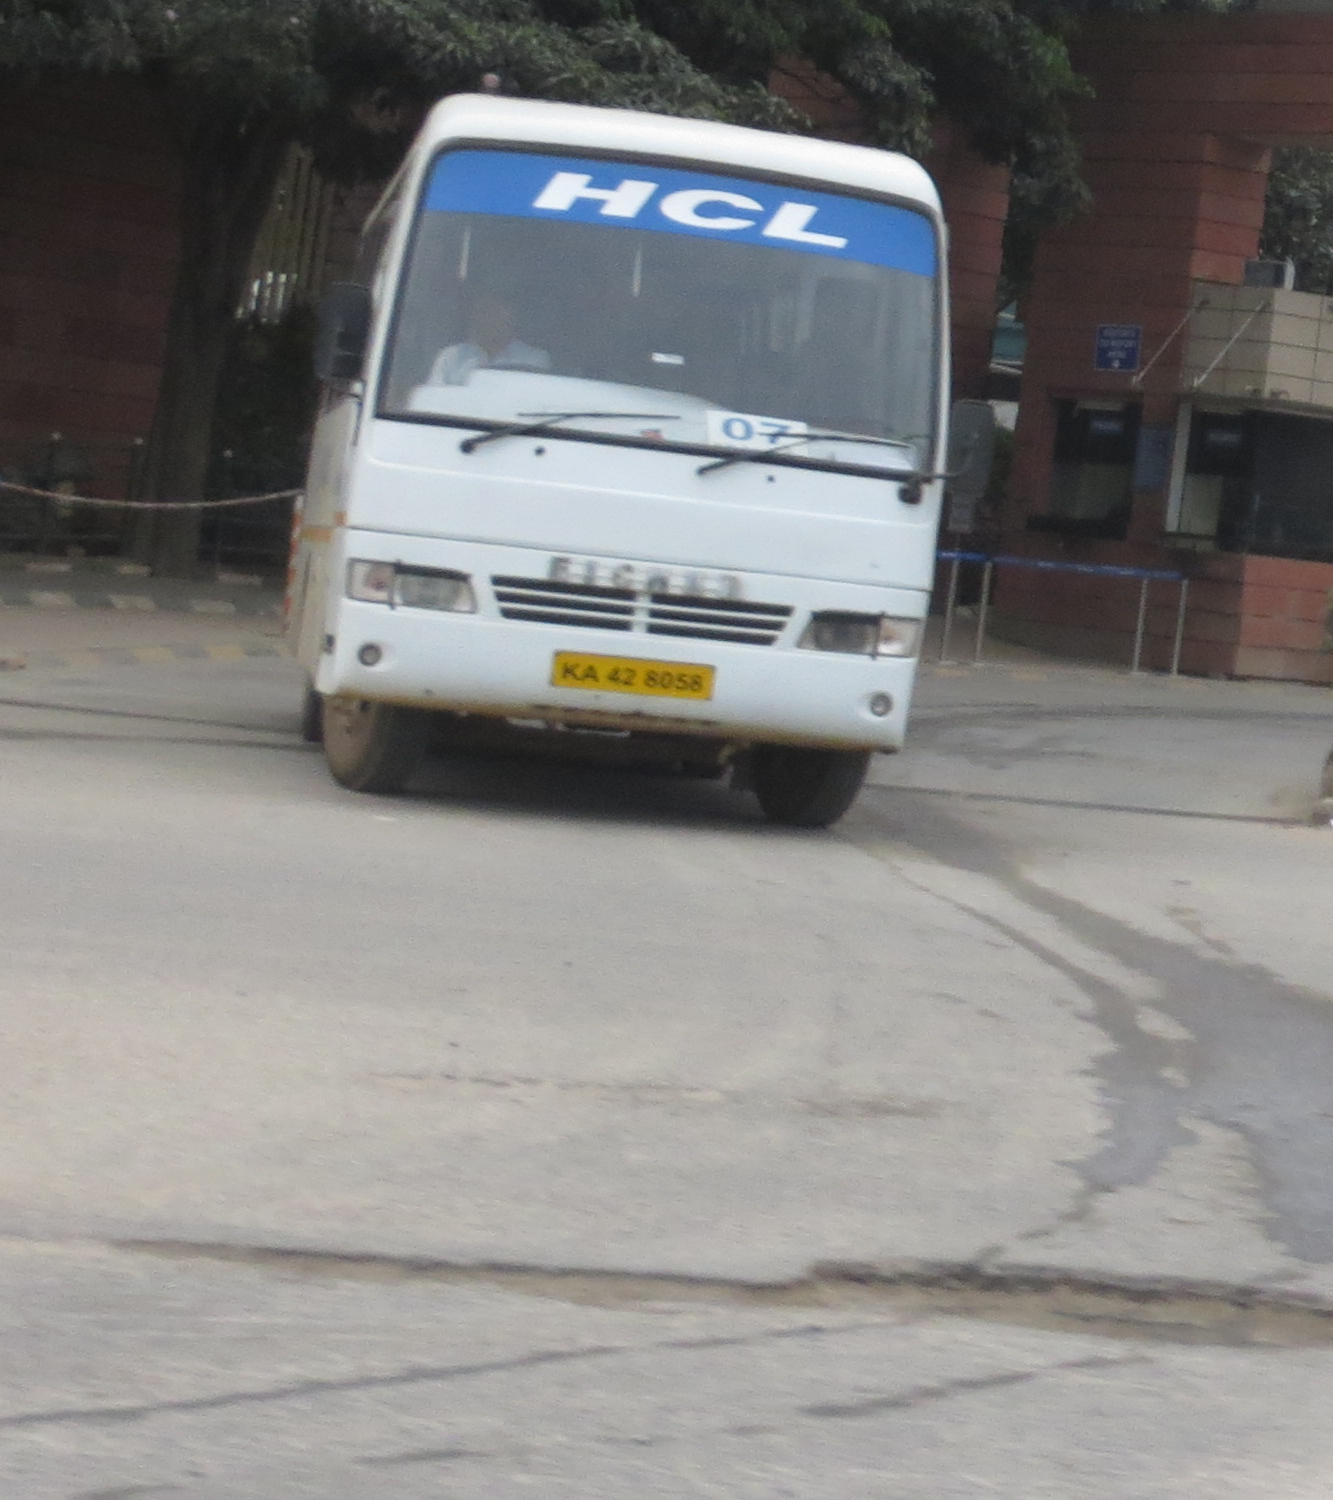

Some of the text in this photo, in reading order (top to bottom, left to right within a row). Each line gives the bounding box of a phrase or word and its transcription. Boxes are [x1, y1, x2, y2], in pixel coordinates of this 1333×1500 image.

[532, 171, 848, 249] HCL
[721, 417, 791, 444] 07
[561, 662, 600, 684] KA
[607, 666, 638, 687] 42
